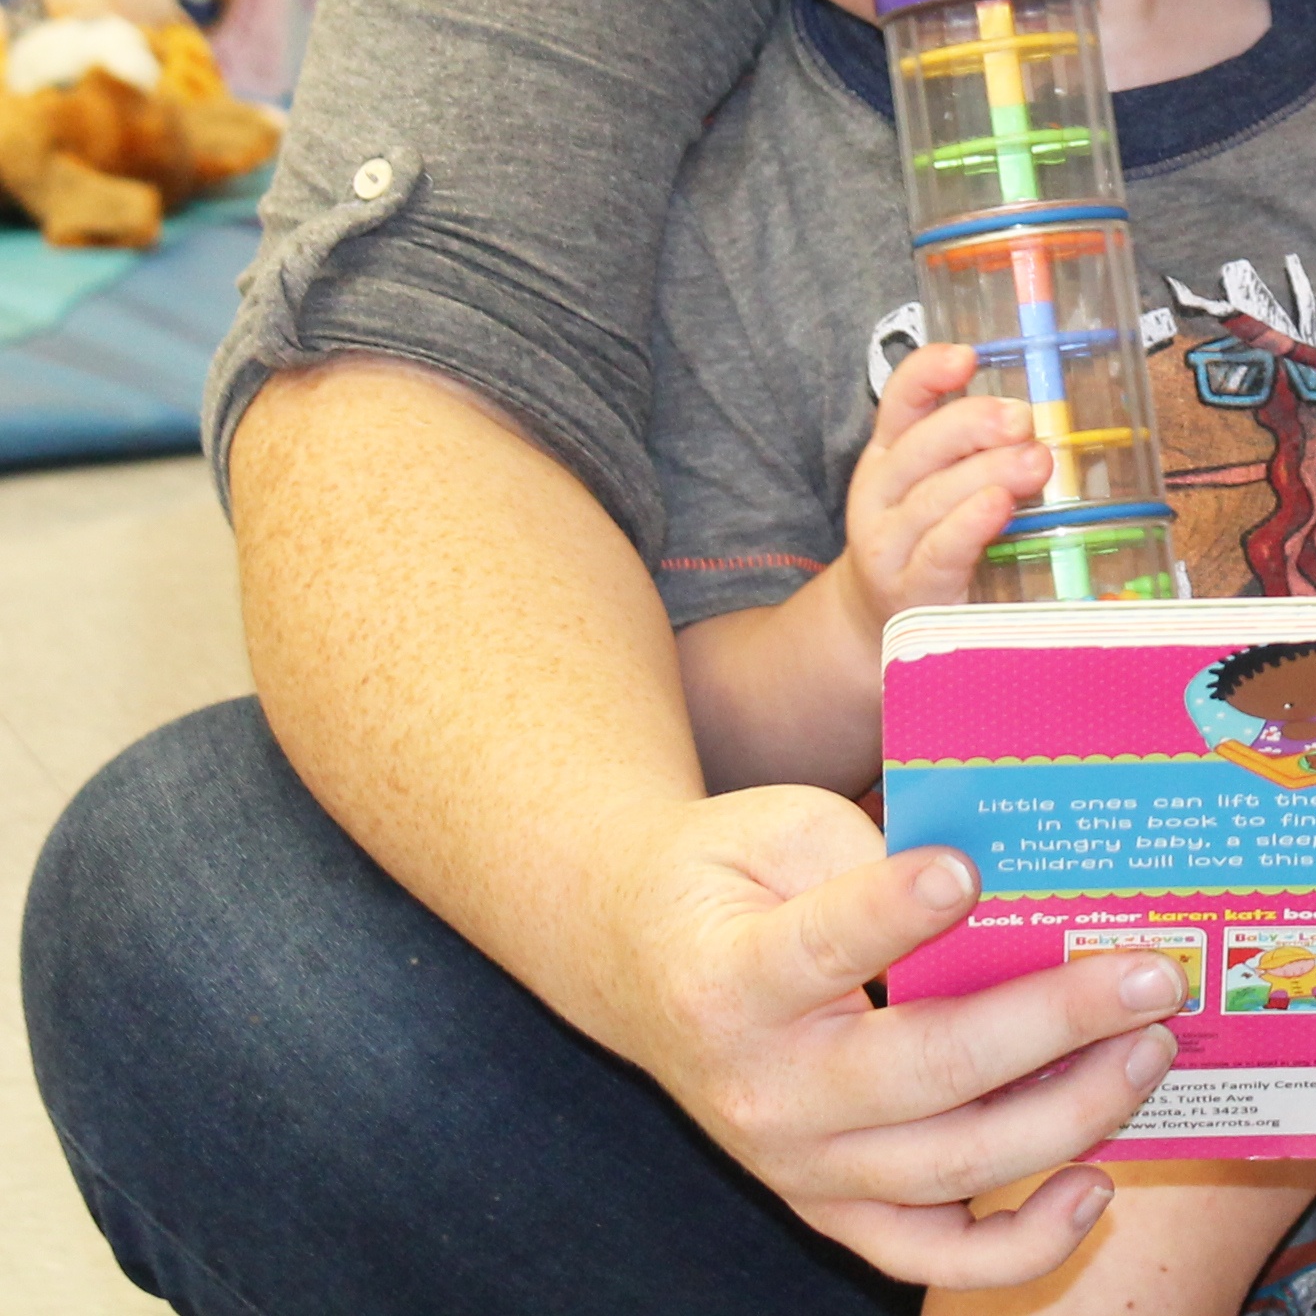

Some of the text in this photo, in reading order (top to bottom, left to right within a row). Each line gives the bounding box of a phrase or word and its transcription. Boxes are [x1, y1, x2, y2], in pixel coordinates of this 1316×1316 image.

[978, 798, 1055, 813] Little
[1070, 798, 1137, 811] ones
[1153, 796, 1202, 809] can
[1218, 794, 1259, 808] lift
[1038, 818, 1061, 831] in
[1077, 817, 1132, 830] this
[1148, 815, 1217, 828] book
[1232, 814, 1265, 827] to
[991, 840, 1005, 852] a
[1020, 837, 1121, 852] hungry
[1226, 835, 1241, 847] a
[998, 856, 1114, 871] Children
[1128, 854, 1173, 869] will
[1188, 853, 1243, 867] love
[1258, 852, 1314, 867] this
[968, 913, 1024, 927] Look
[1030, 912, 1068, 925] for
[1075, 911, 1142, 924] other
[1148, 910, 1218, 922] karen
[1224, 909, 1277, 921] katz
[1075, 934, 1195, 946] Baby Loves
[1235, 933, 1278, 944] Baby
[1161, 1082, 1216, 1092] Carrots
[1221, 1080, 1271, 1092] Family
[1177, 1094, 1220, 1104] Tuttle
[1226, 1094, 1253, 1102] Ave
[1191, 1107, 1207, 1116] FL
[1212, 1106, 1259, 1115] 34239
